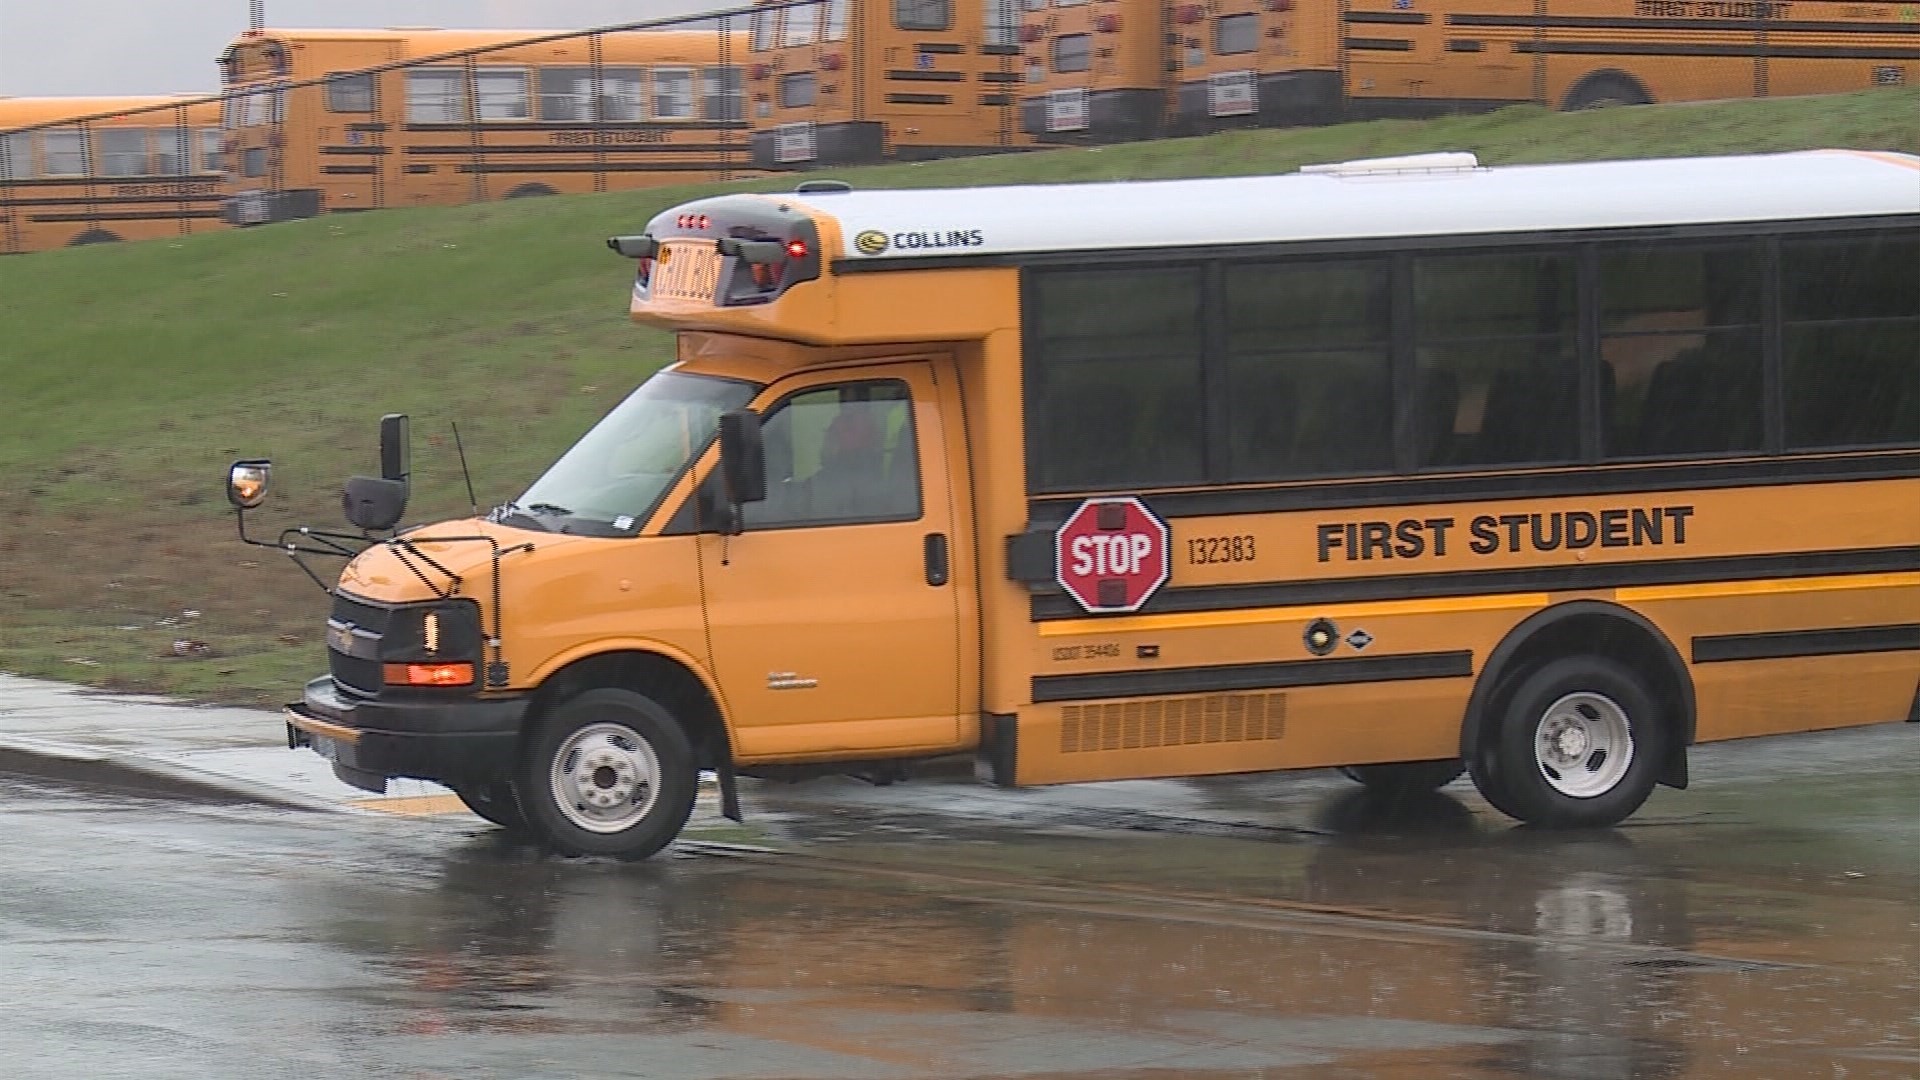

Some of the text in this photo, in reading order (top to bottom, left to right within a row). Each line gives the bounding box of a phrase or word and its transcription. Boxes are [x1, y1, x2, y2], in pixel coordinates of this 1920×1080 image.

[1634, 0, 1696, 16] FIRST
[893, 229, 984, 249] COLLINS
[1316, 505, 1695, 563] FIRST STUDENT
[1071, 533, 1152, 577] STOP
[1187, 535, 1256, 565] 132383
